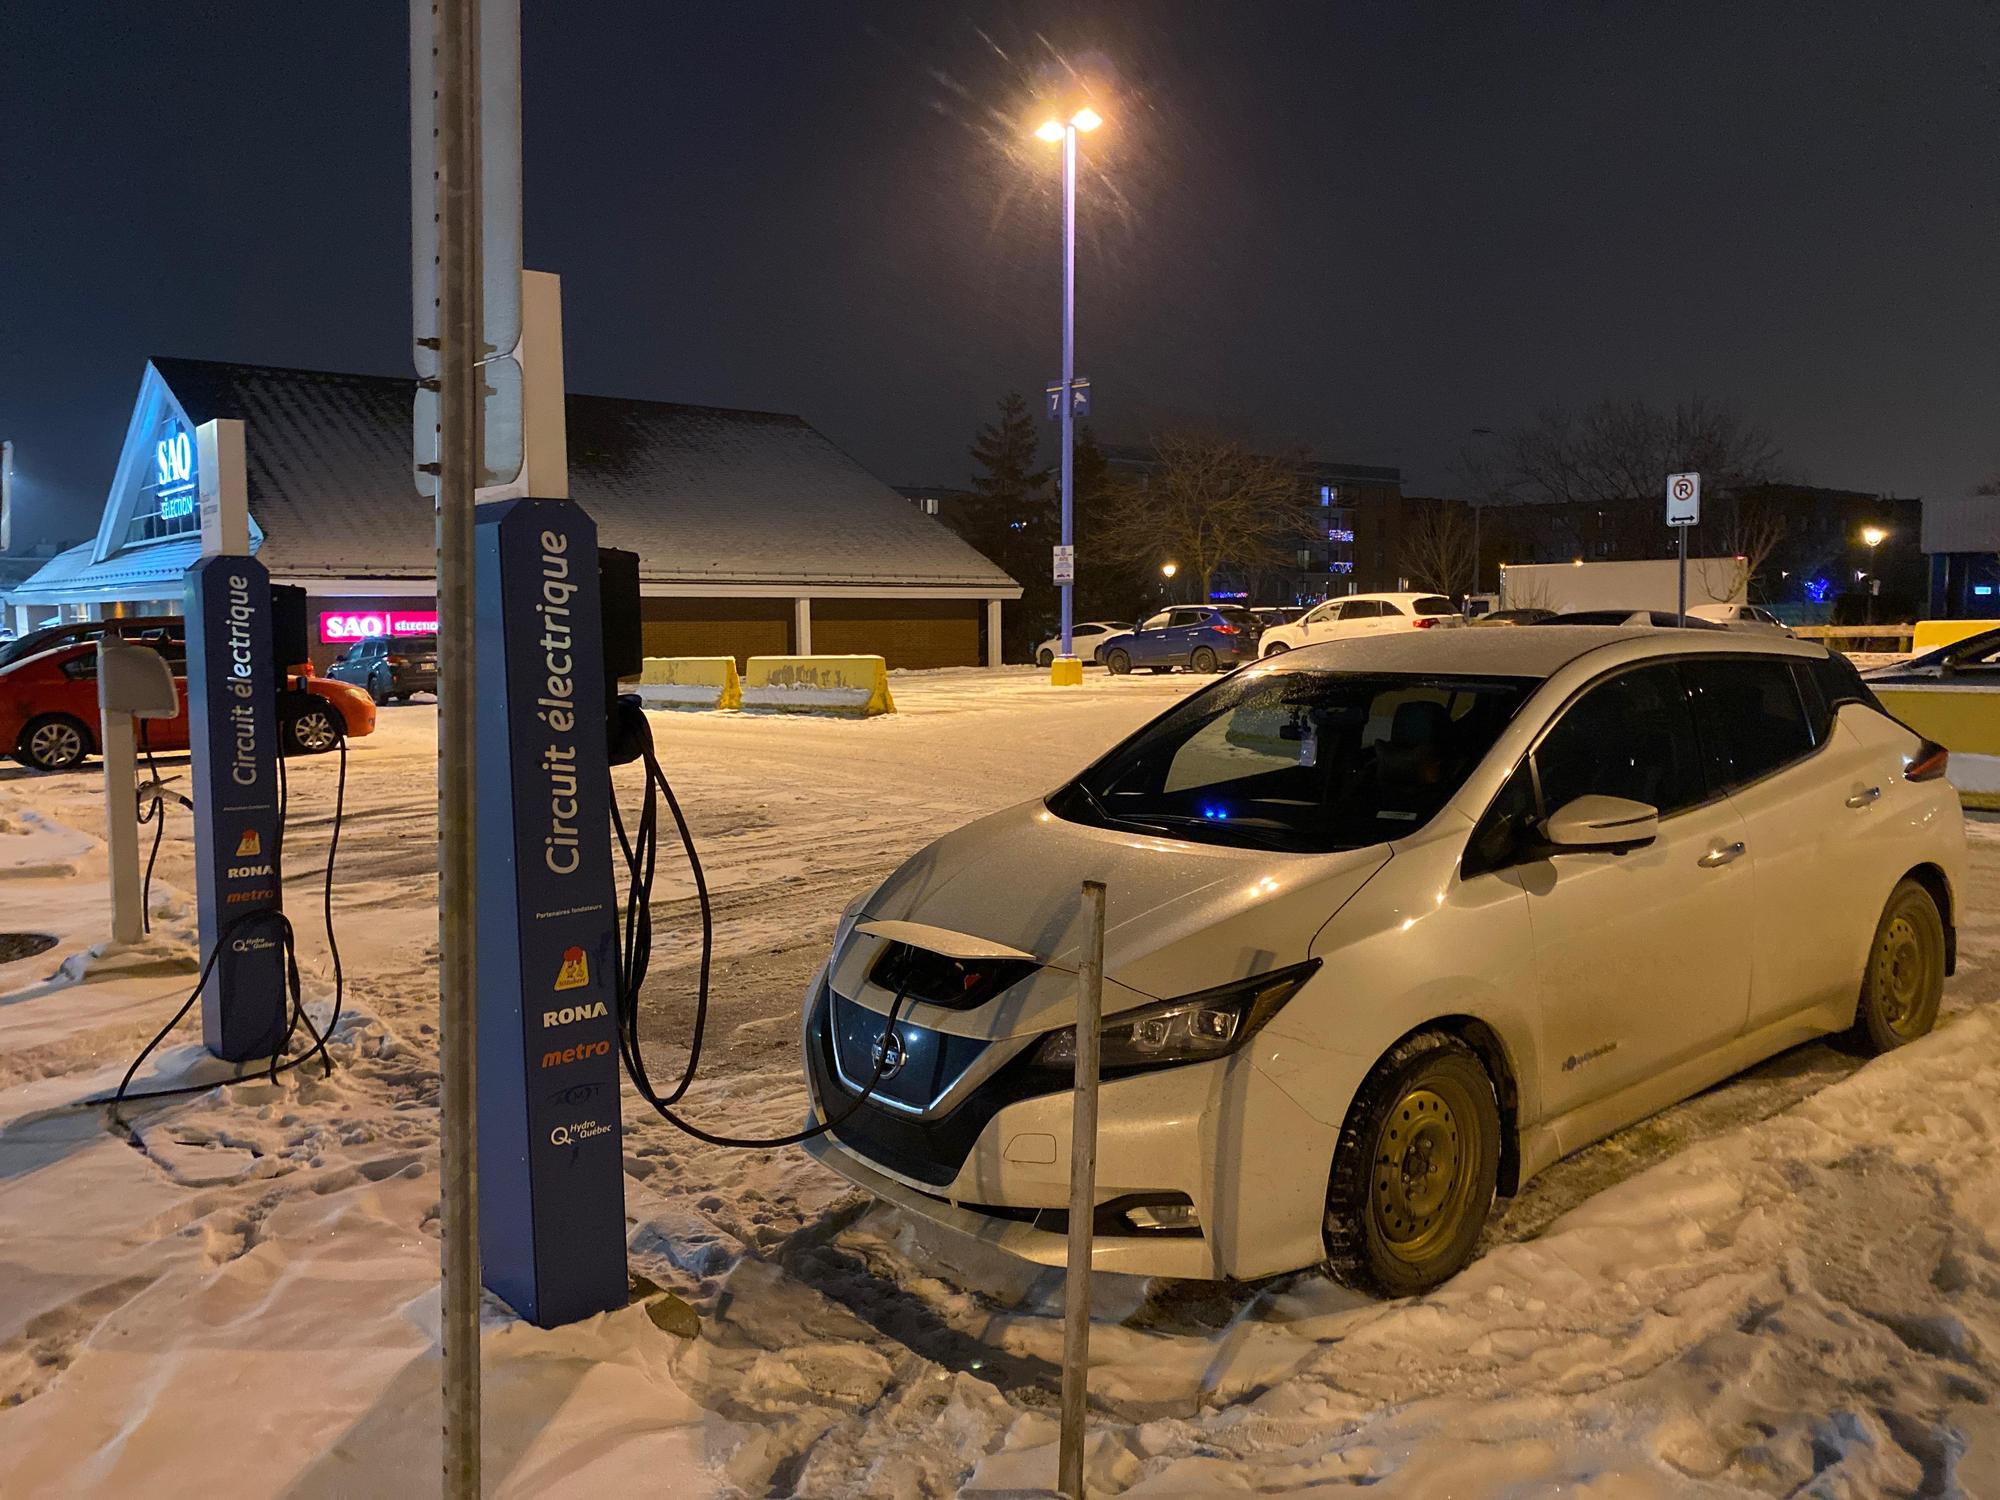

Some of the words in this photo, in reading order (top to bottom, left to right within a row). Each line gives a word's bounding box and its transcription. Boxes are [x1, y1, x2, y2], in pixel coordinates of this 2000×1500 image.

[1051, 394, 1059, 410] 7
[158, 433, 191, 485] SAQ
[225, 575, 255, 698] électrique
[326, 616, 382, 637] SAQ
[394, 620, 438, 631] SÉLECTIO
[535, 529, 578, 732] électrique
[230, 704, 257, 786] Circuit
[542, 745, 580, 875] Circuit
[227, 865, 274, 879] RONA
[226, 890, 274, 904] metro
[543, 1001, 609, 1028] RONA
[541, 1039, 610, 1069] metro
[569, 1120, 596, 1133] Hydro
[580, 1124, 612, 1139] Québec
